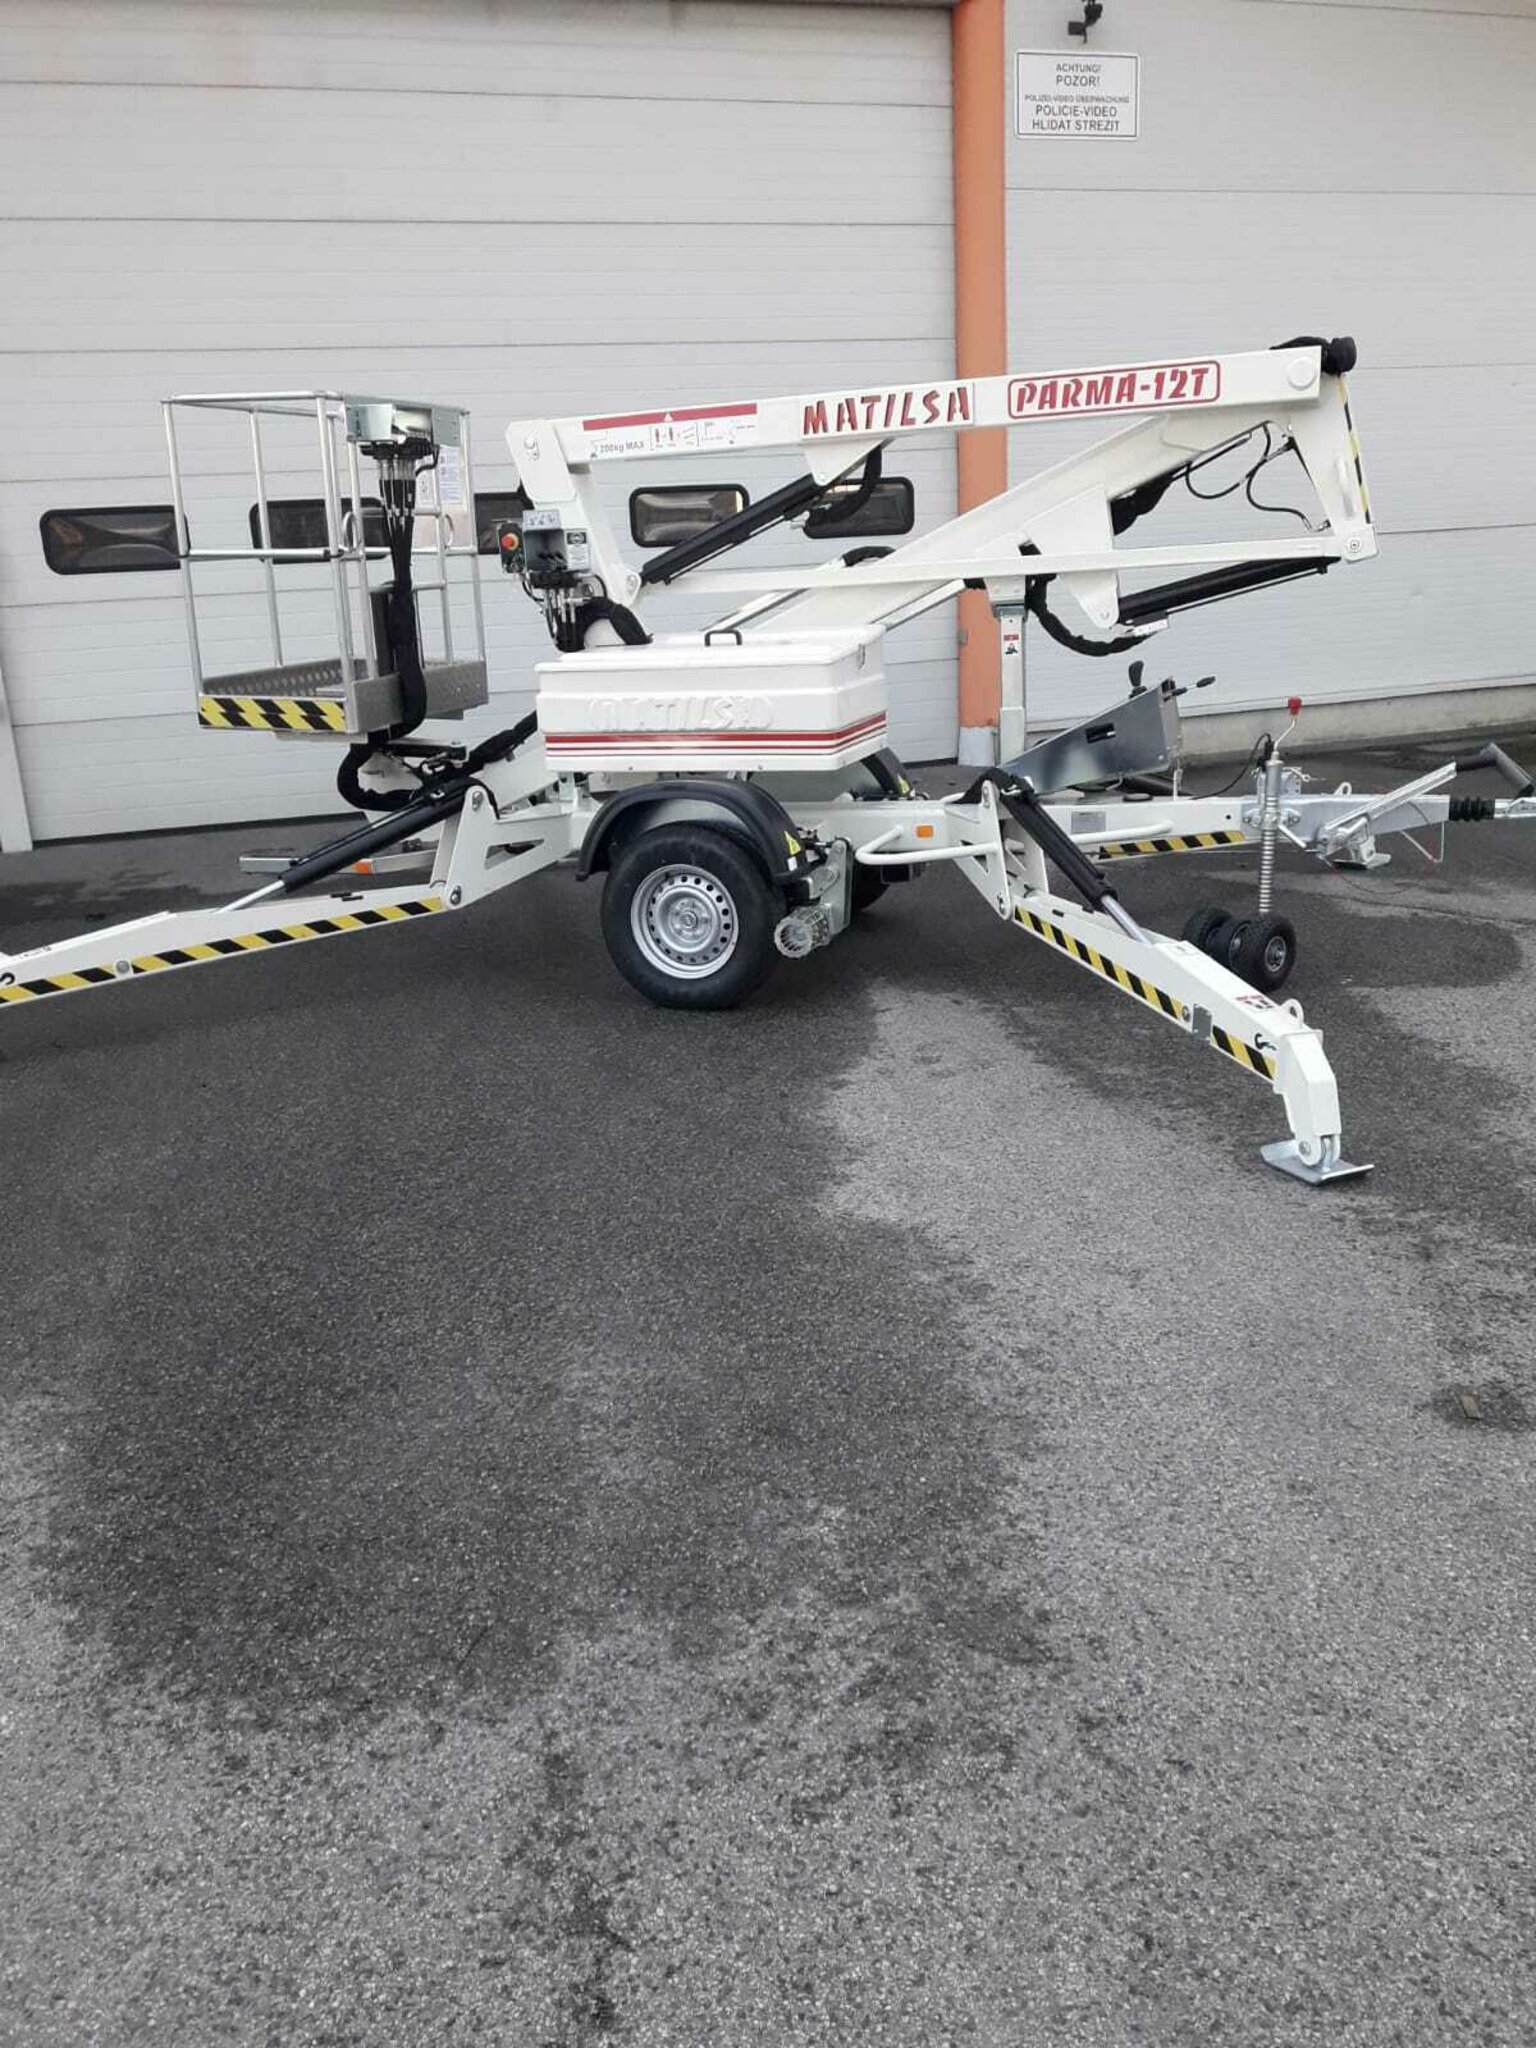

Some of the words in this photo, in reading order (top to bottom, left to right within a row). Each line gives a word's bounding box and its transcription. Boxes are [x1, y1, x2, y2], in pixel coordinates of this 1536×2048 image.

[1056, 63, 1101, 73] ACHTUNG!
[1056, 75, 1100, 87] POZOR!
[1035, 104, 1117, 117] POLICIE-VIDEO
[1016, 367, 1209, 412] PARMA-12T
[803, 386, 970, 435] MATILSA
[625, 440, 645, 450] MAX
